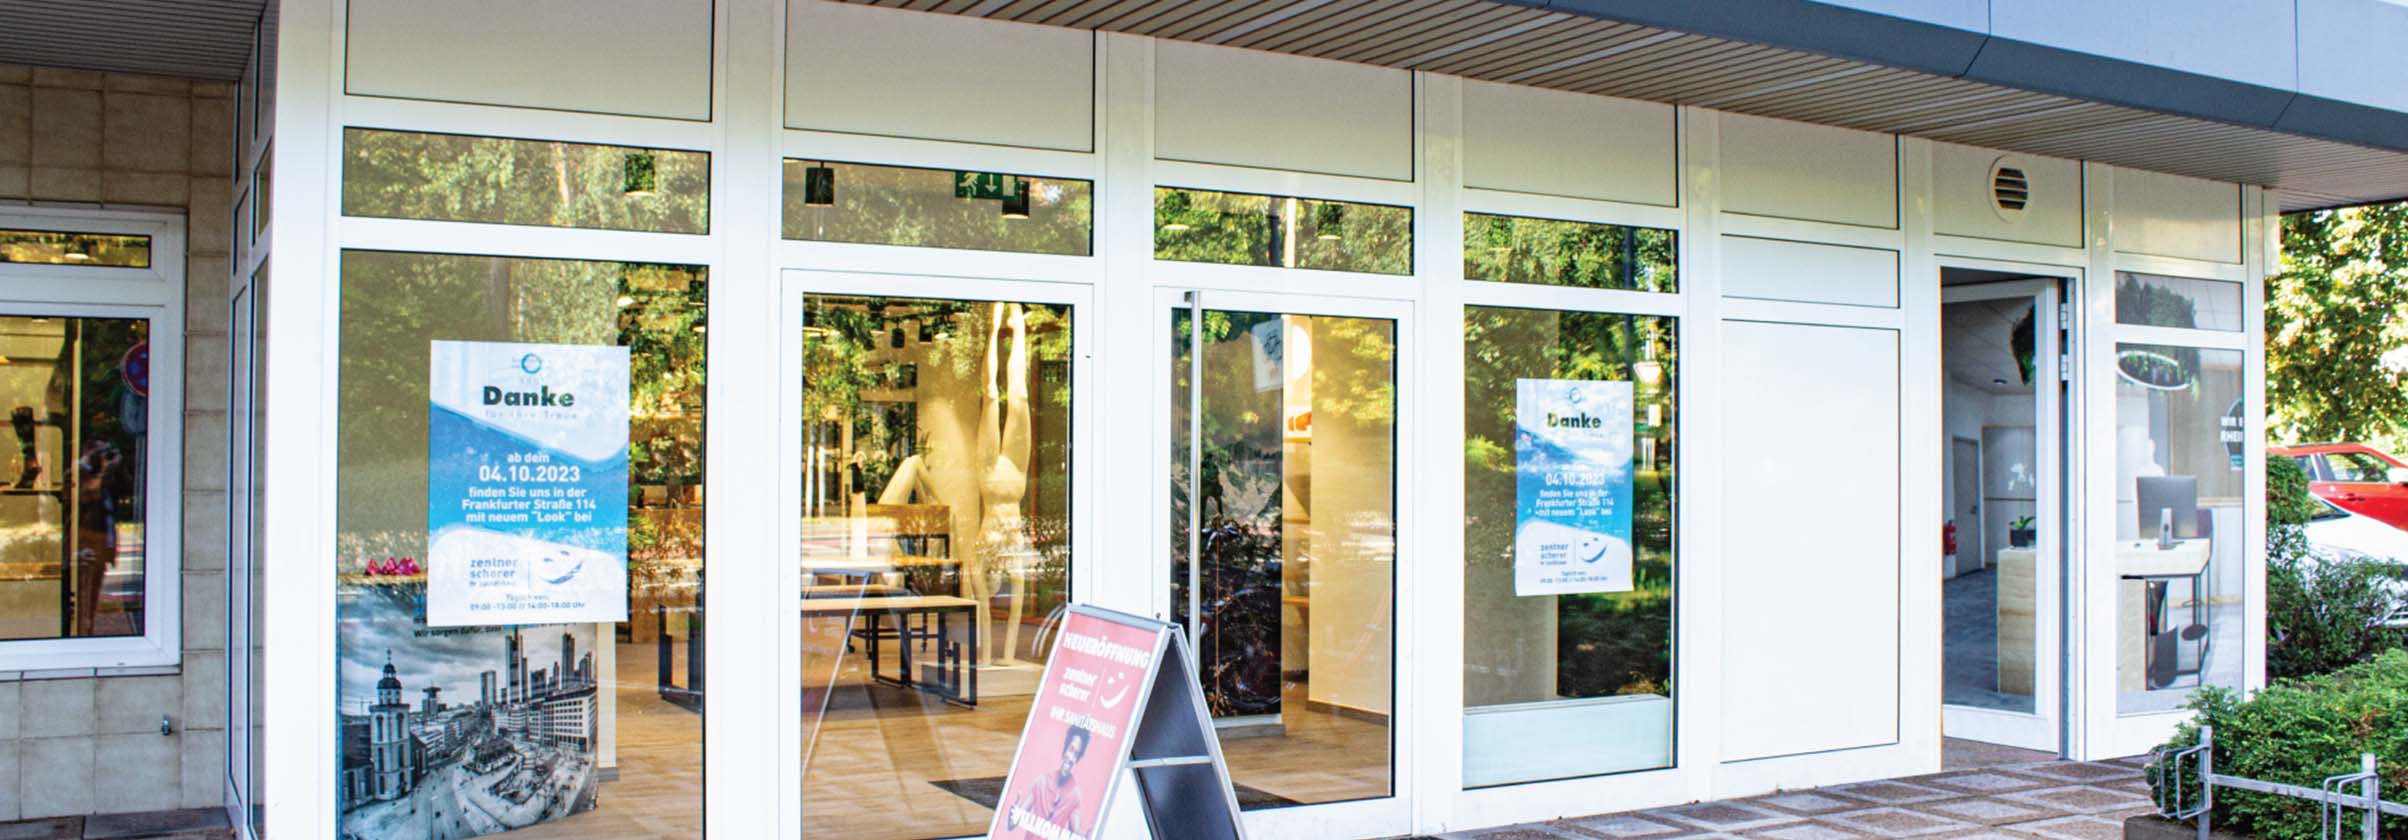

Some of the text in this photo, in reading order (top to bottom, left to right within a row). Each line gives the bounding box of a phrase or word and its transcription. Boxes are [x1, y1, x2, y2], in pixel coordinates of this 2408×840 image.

[483, 385, 575, 407] Danke
[1546, 411, 1602, 428] Danke
[507, 452, 550, 463] ab dem
[479, 465, 581, 482] 04.10.2023
[1545, 471, 1606, 487] 04.10.2023
[468, 487, 587, 498] finden Sie uns in der
[461, 499, 597, 511] Frankfurter Straße 114
[466, 512, 486, 523] mit
[488, 513, 529, 523] neuem
[574, 512, 593, 523] bei
[414, 628, 429, 638] Wir
[431, 626, 457, 638] sorgen
[1063, 631, 1152, 669] NEUERÖFFNUNG
